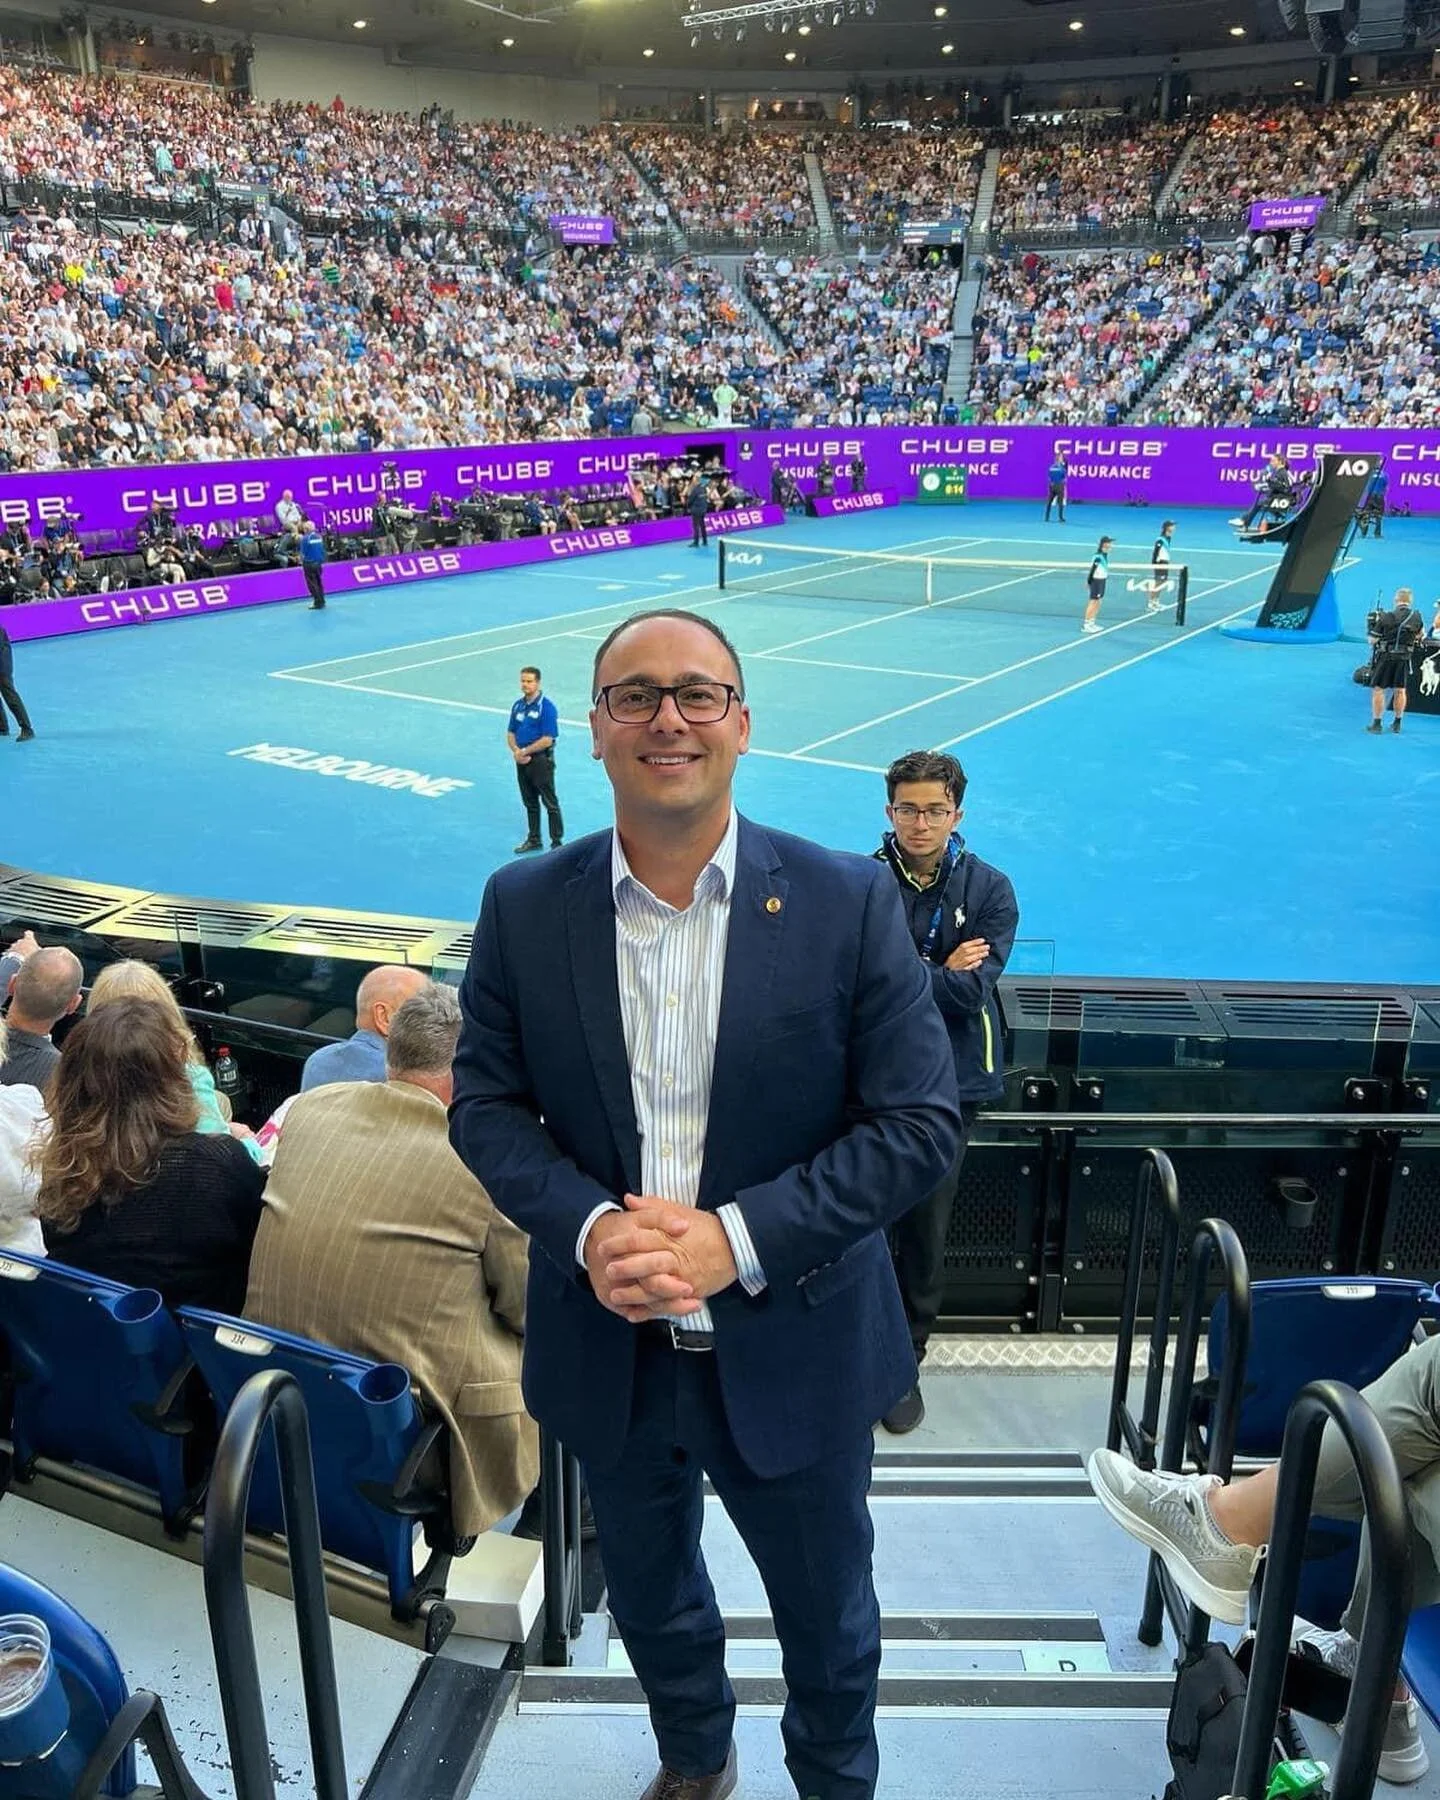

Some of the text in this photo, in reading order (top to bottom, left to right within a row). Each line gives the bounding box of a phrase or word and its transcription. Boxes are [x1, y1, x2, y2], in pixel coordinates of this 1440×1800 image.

[1262, 205, 1315, 216] CHUBB
[767, 441, 859, 458] CHUBB
[901, 439, 1009, 454] CHUBB
[1054, 440, 1163, 456] CHUBB
[308, 470, 423, 497] CHUBB
[457, 460, 550, 484] CHUBB
[1067, 464, 1152, 479] NSURANCE
[122, 482, 265, 513] CHUBB
[832, 493, 884, 511] CHUBB
[550, 530, 632, 554] CHUBB
[353, 553, 460, 583] CHUBB
[80, 584, 229, 623] CHUBB
[226, 742, 475, 798] MELBOURNE
